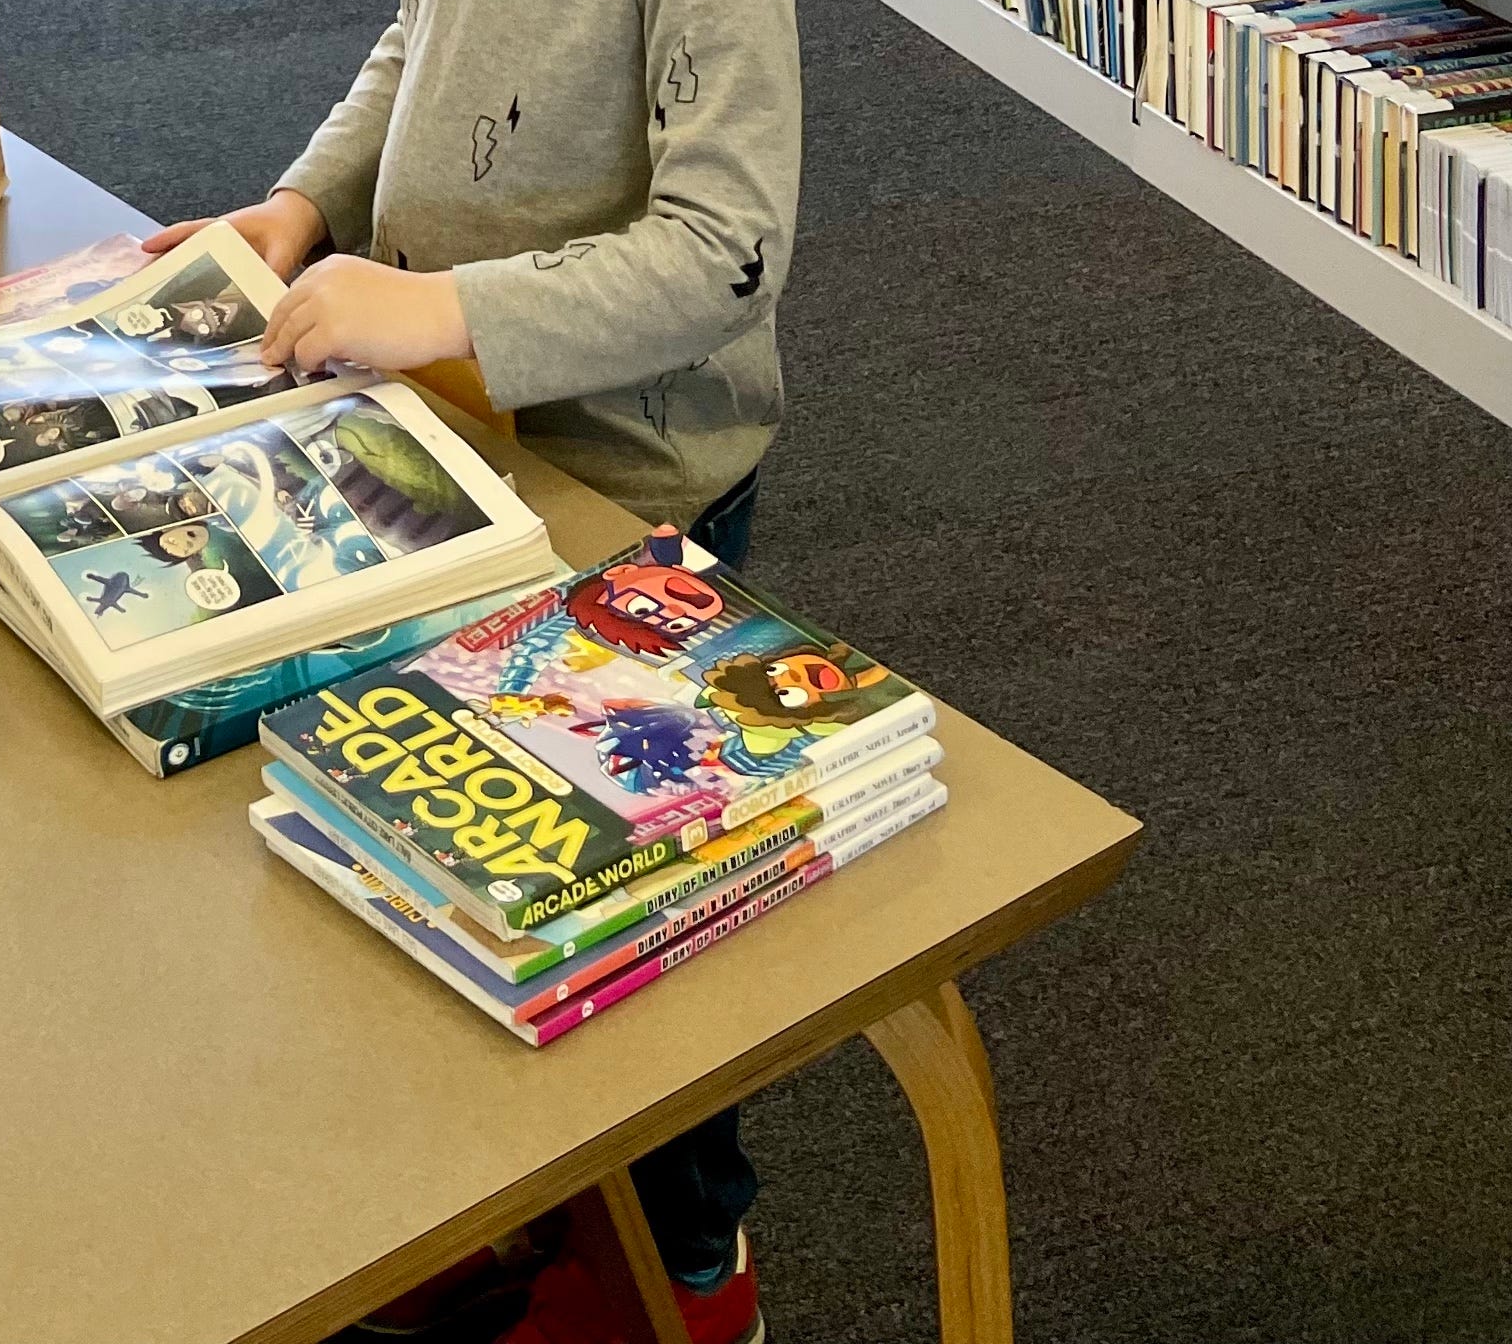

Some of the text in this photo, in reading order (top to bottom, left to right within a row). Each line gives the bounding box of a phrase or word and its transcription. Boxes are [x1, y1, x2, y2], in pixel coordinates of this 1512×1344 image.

[315, 689, 577, 885] ARCADE
[358, 686, 590, 869] WORLD
[727, 791, 779, 822] ROBOT
[521, 842, 666, 929] ARCADE WORLD
[637, 929, 669, 955] DIARY
[673, 917, 687, 935] OF
[692, 906, 706, 923] AN
[742, 860, 787, 893] WARRIOR
[646, 887, 679, 915] DIARY
[683, 877, 698, 895] OF
[702, 865, 717, 884] AN
[751, 824, 797, 859] WARRIOR
[661, 943, 692, 970] DIARY
[696, 932, 710, 950] OF
[714, 920, 728, 937] AN
[762, 874, 805, 910] WARRIOR
